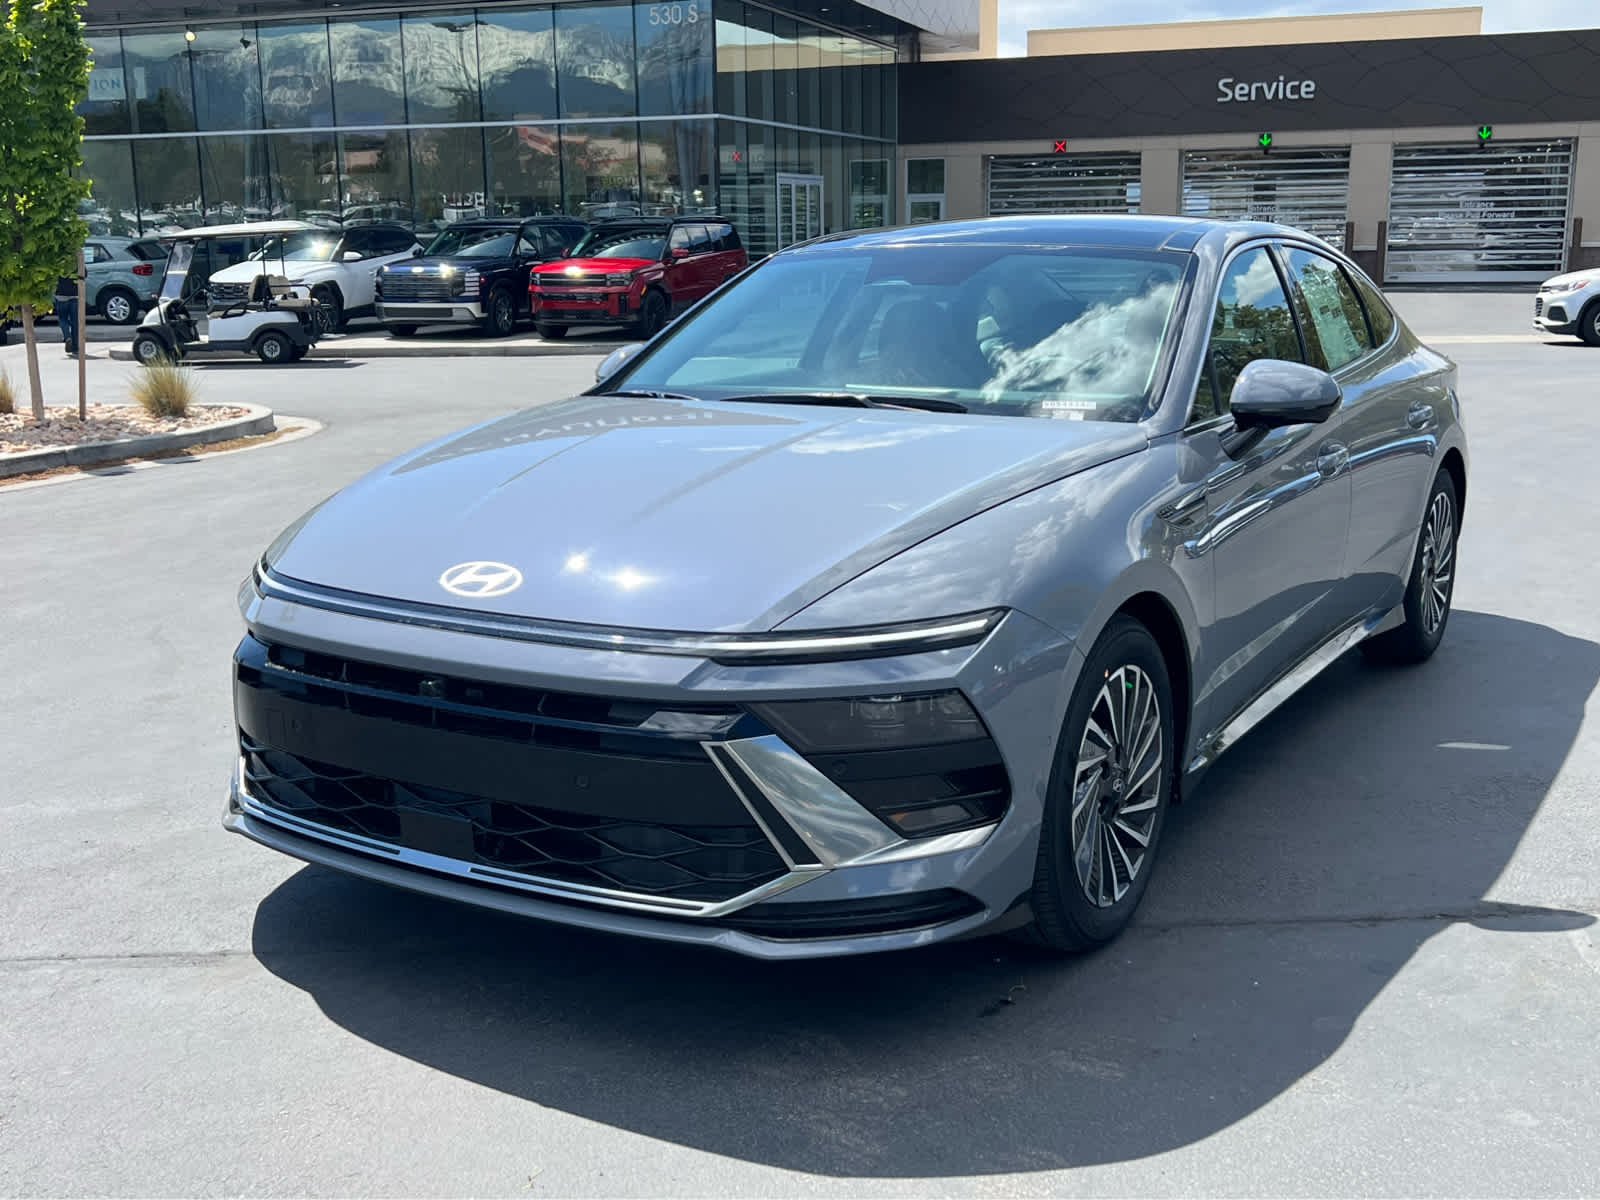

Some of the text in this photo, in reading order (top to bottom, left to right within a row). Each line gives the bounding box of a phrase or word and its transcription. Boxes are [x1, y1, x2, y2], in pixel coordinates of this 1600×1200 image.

[648, 4, 699, 25] 530 S
[1216, 75, 1316, 102] Service
